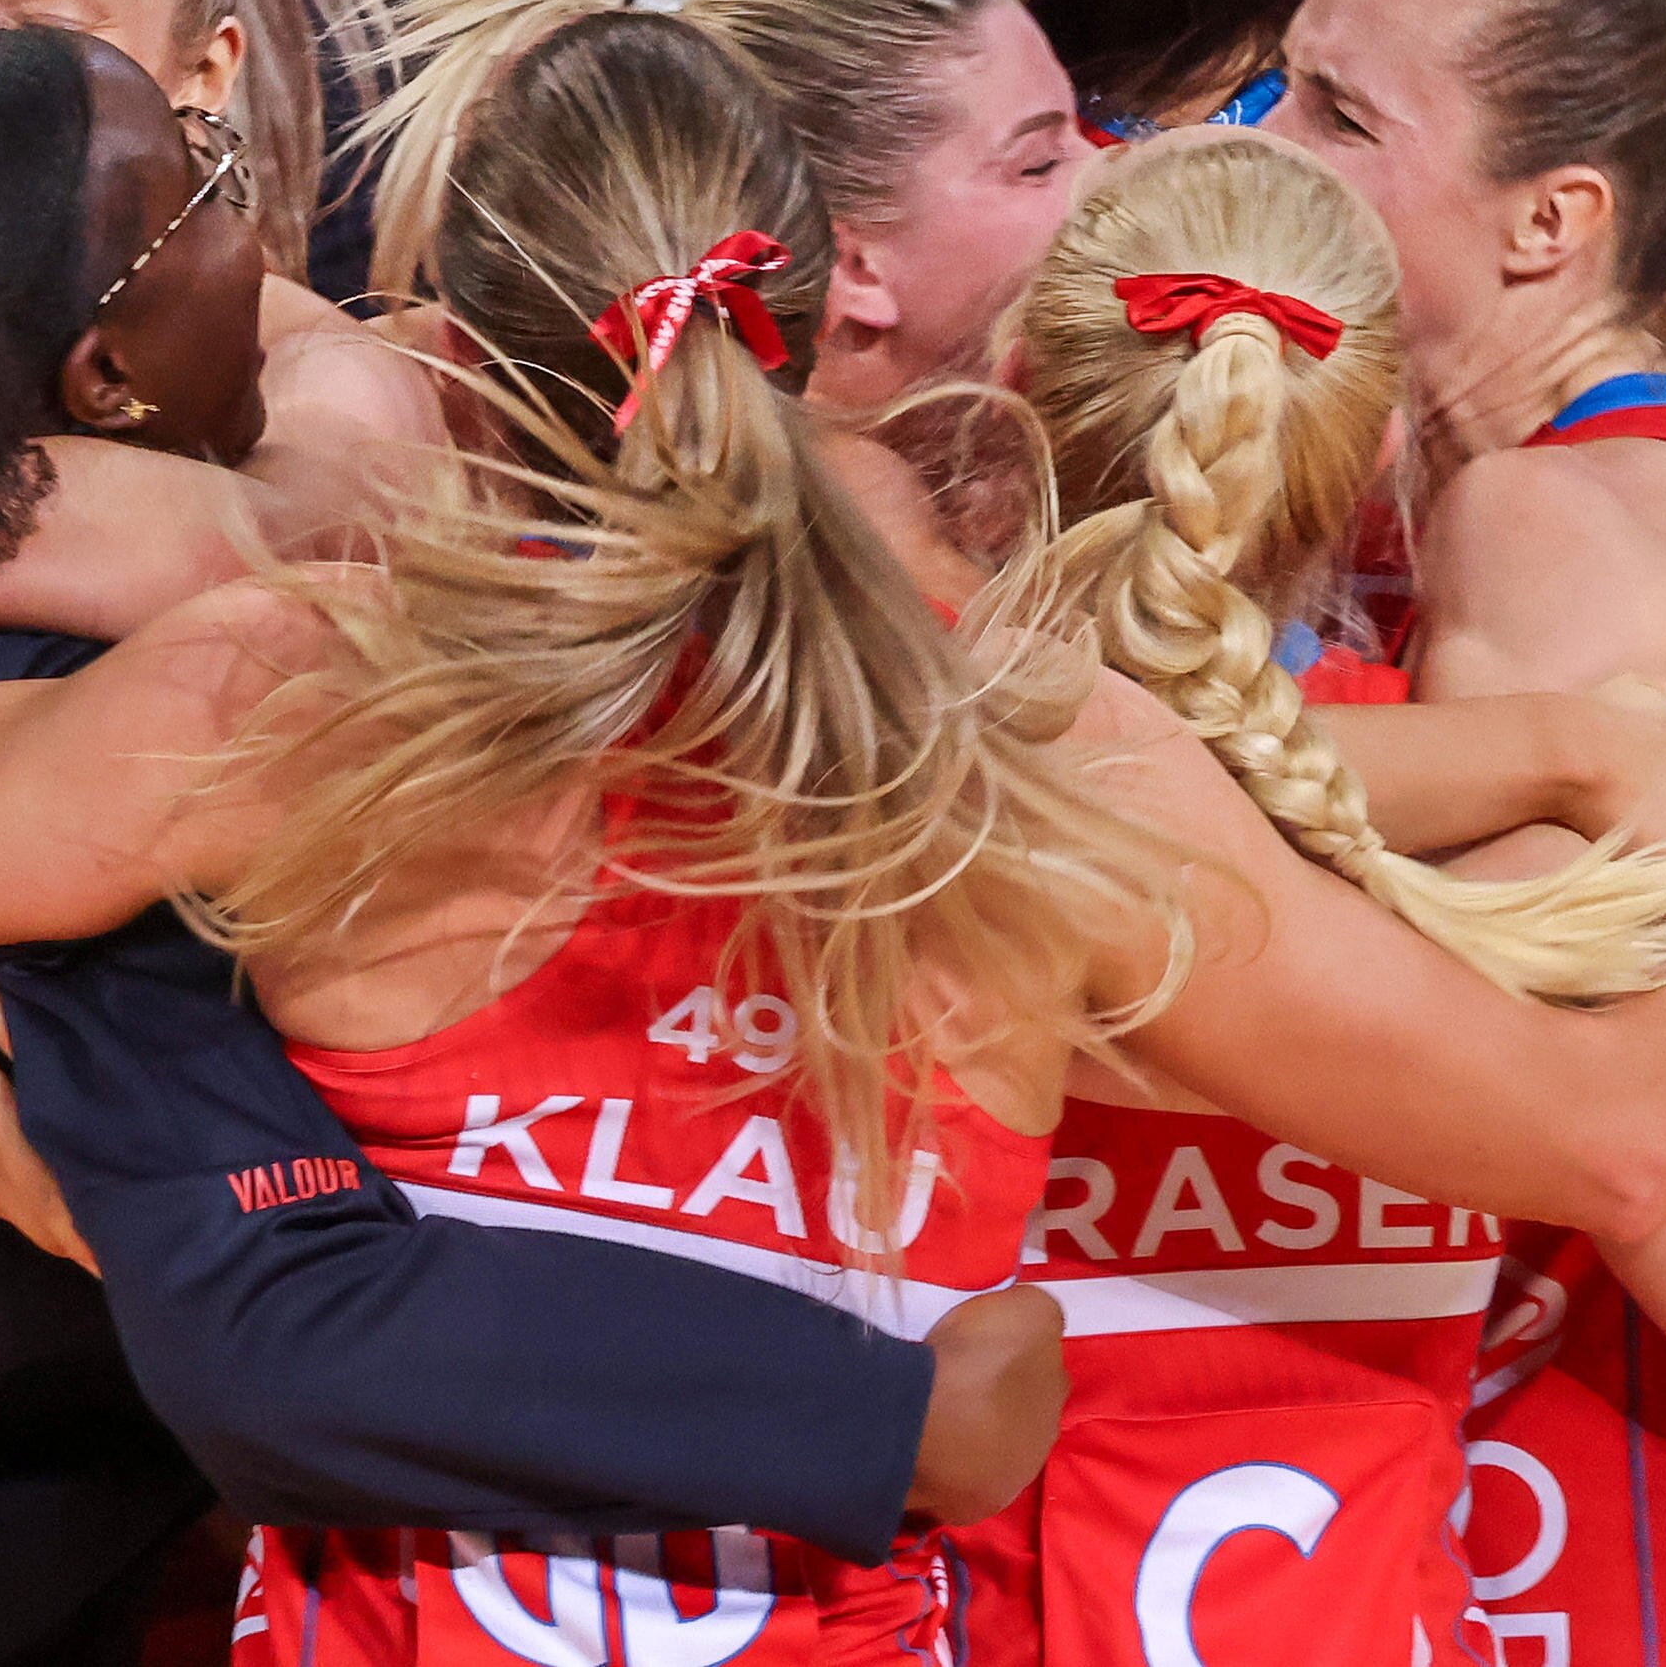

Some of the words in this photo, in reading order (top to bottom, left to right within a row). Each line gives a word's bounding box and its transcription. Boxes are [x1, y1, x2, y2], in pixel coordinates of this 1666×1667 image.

[647, 985, 798, 1073] 49
[227, 1157, 361, 1214] VALOUR
[446, 1094, 941, 1254] KLAU
